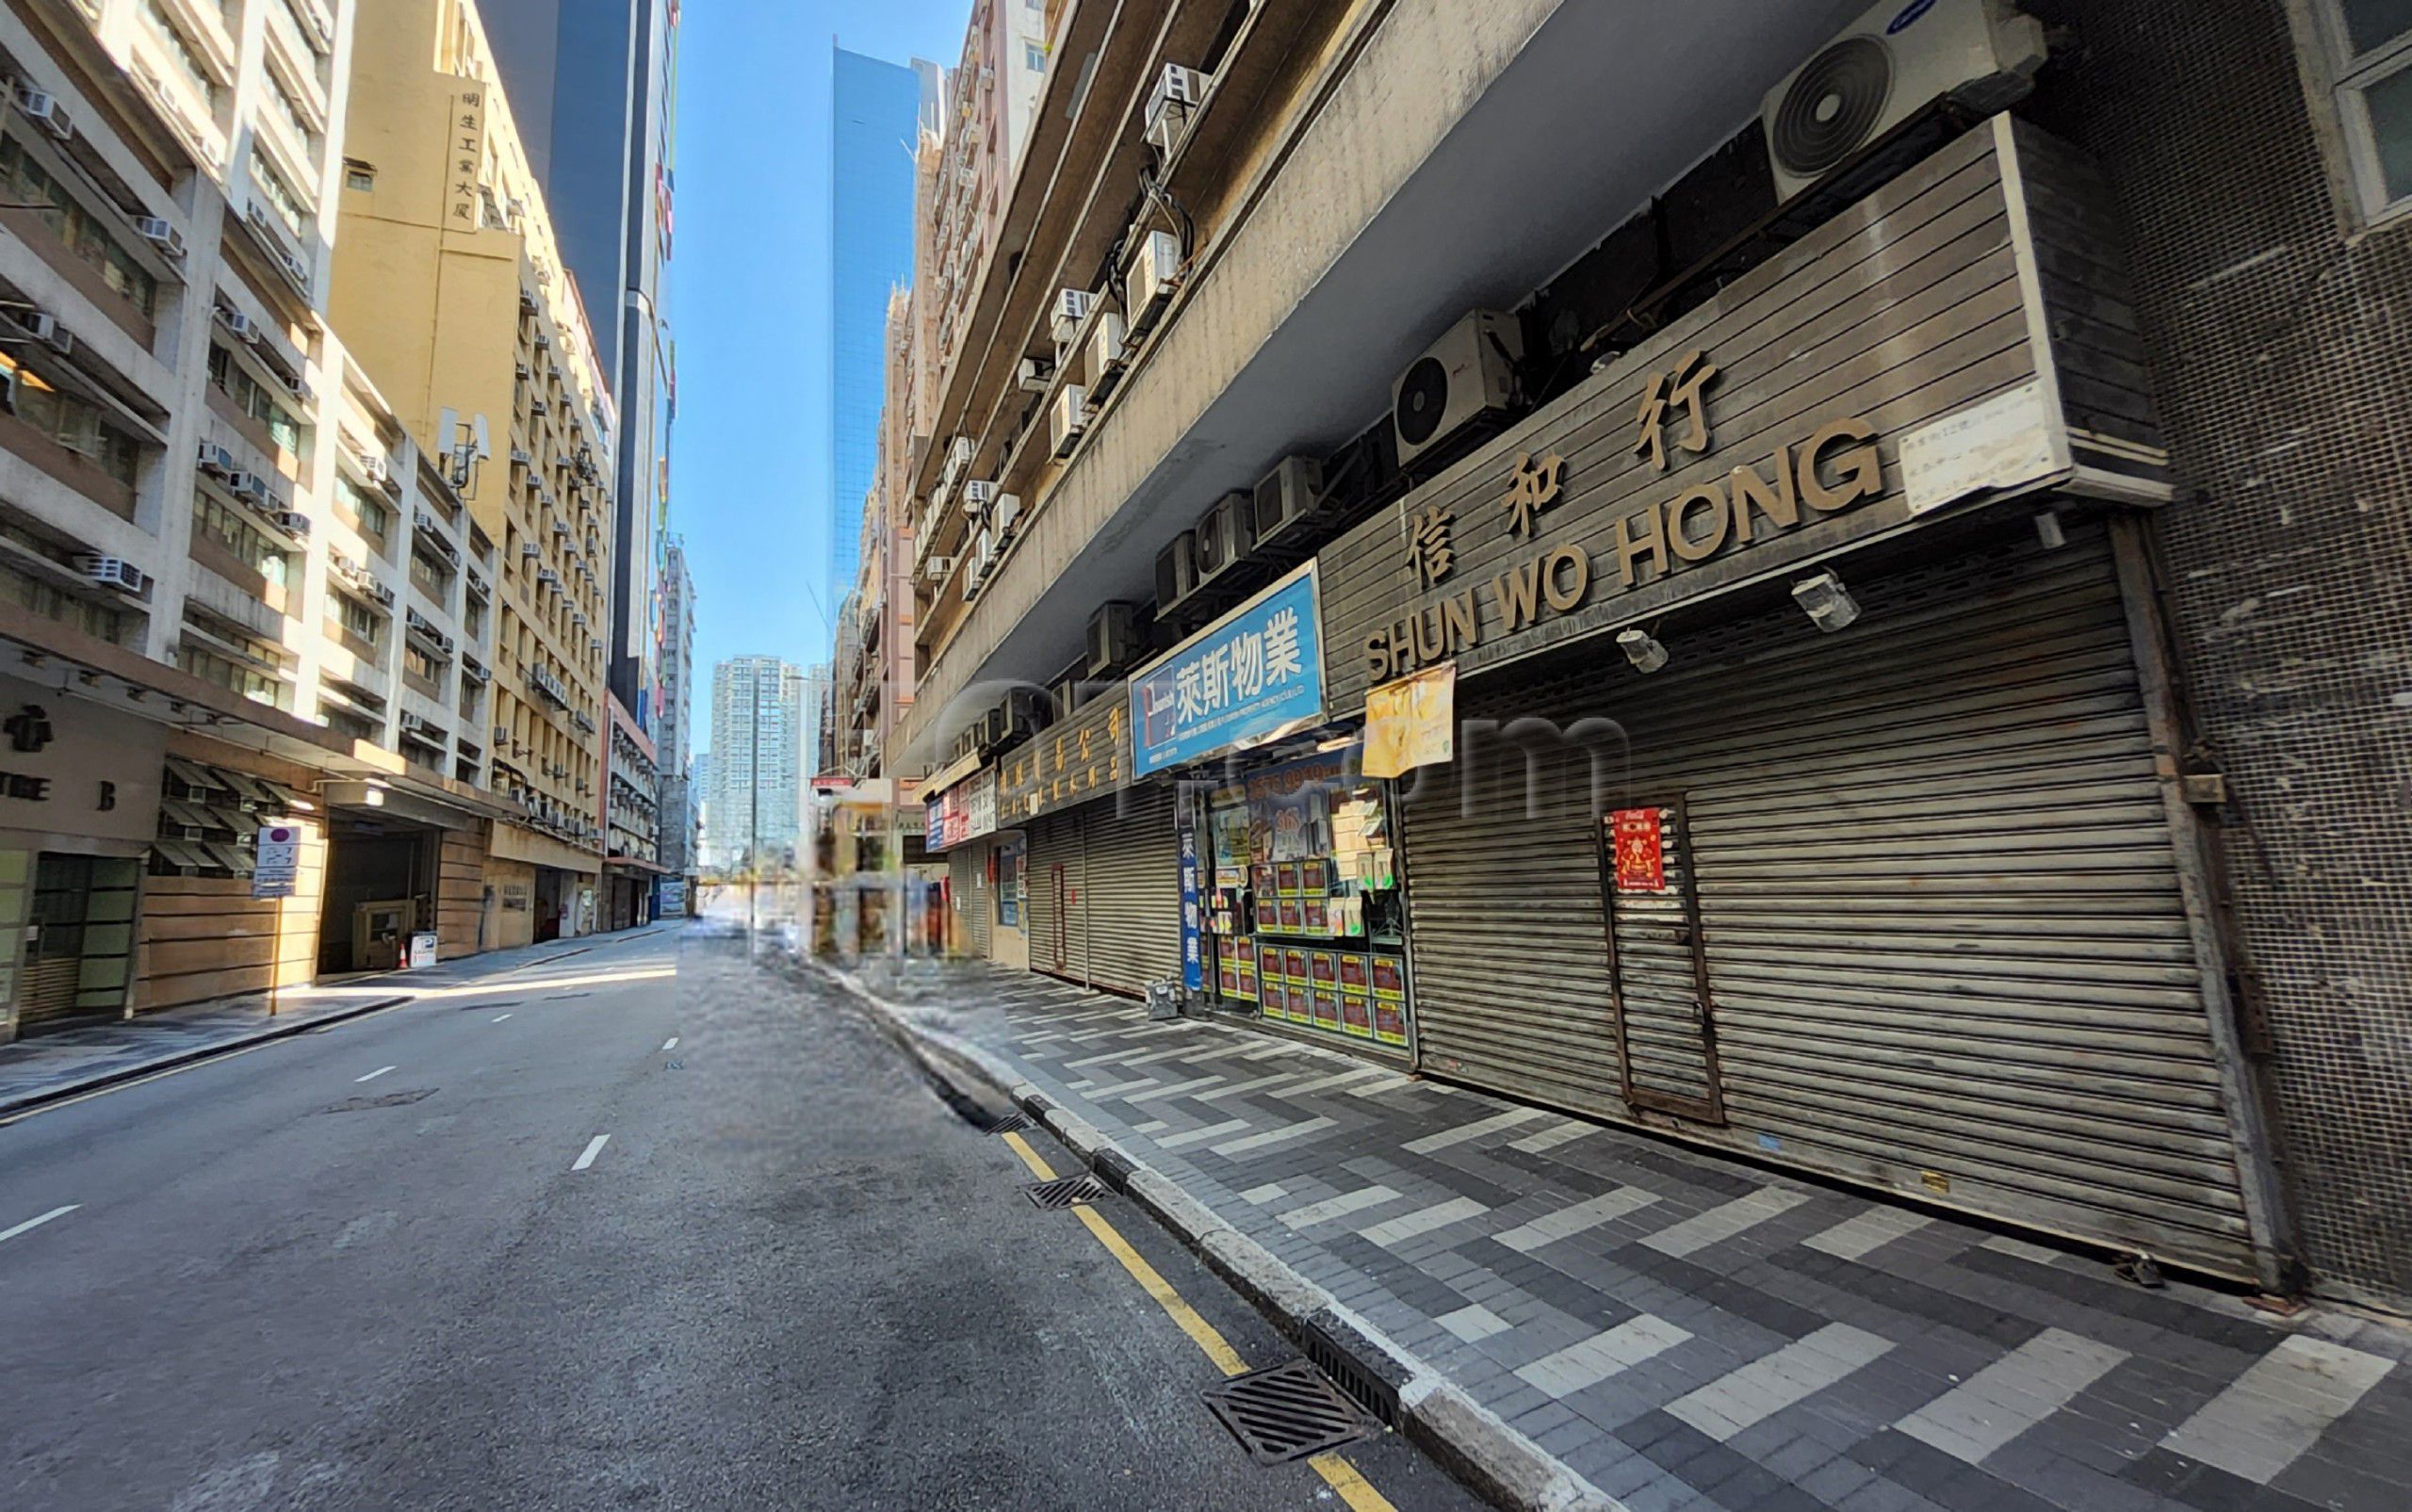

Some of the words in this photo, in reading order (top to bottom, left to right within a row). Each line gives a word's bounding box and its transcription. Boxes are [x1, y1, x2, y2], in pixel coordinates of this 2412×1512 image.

[453, 92, 481, 220] 明生工業大廈
[1363, 588, 1479, 682] SHUN
[1491, 544, 1589, 630] WO
[1615, 417, 1884, 587] HONG
[1407, 350, 1718, 591] 信和行
[1176, 606, 1303, 724] 萊斯物業
